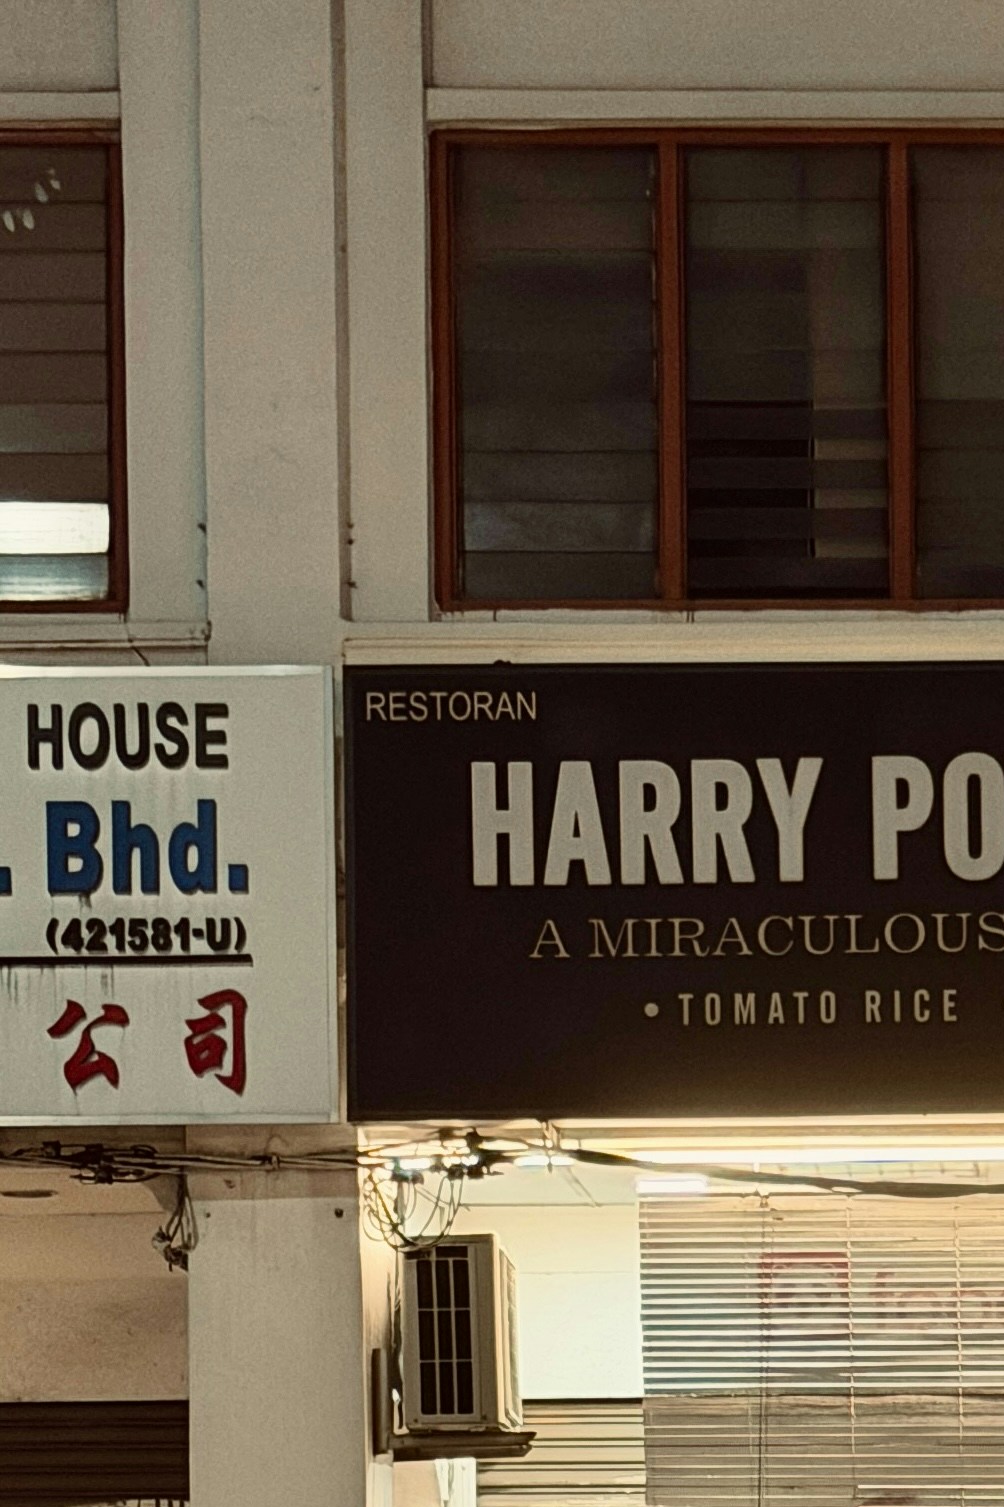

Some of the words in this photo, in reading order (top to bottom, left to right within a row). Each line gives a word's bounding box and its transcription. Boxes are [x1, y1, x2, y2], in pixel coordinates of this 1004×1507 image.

[366, 691, 537, 721] RESTORAN
[27, 701, 230, 771] HOUSE
[45, 799, 250, 896] Bhd.
[470, 757, 824, 886] HARRY
[46, 916, 247, 953] (421581-U)
[528, 918, 571, 959] A
[678, 990, 837, 1026] TOMATO
[865, 988, 958, 1024] RICE
[46, 988, 249, 1097] 公司
